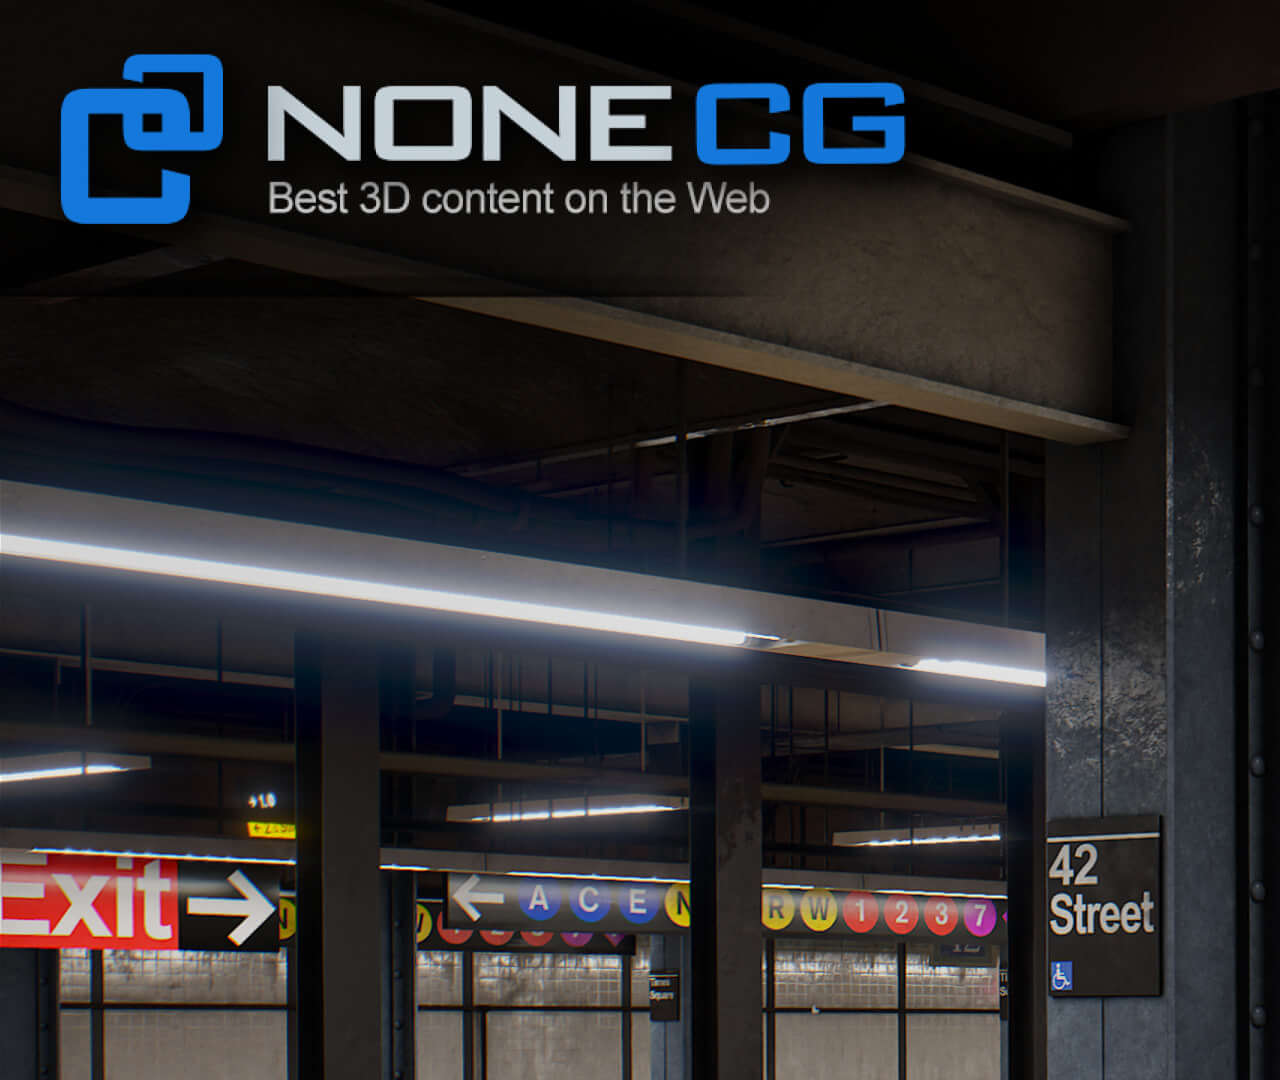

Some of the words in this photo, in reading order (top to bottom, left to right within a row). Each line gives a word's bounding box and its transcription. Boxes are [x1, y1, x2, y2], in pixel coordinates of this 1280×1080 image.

[1049, 843, 1099, 886] 42
[0, 853, 173, 940] Exit
[1049, 893, 1155, 936] Street
